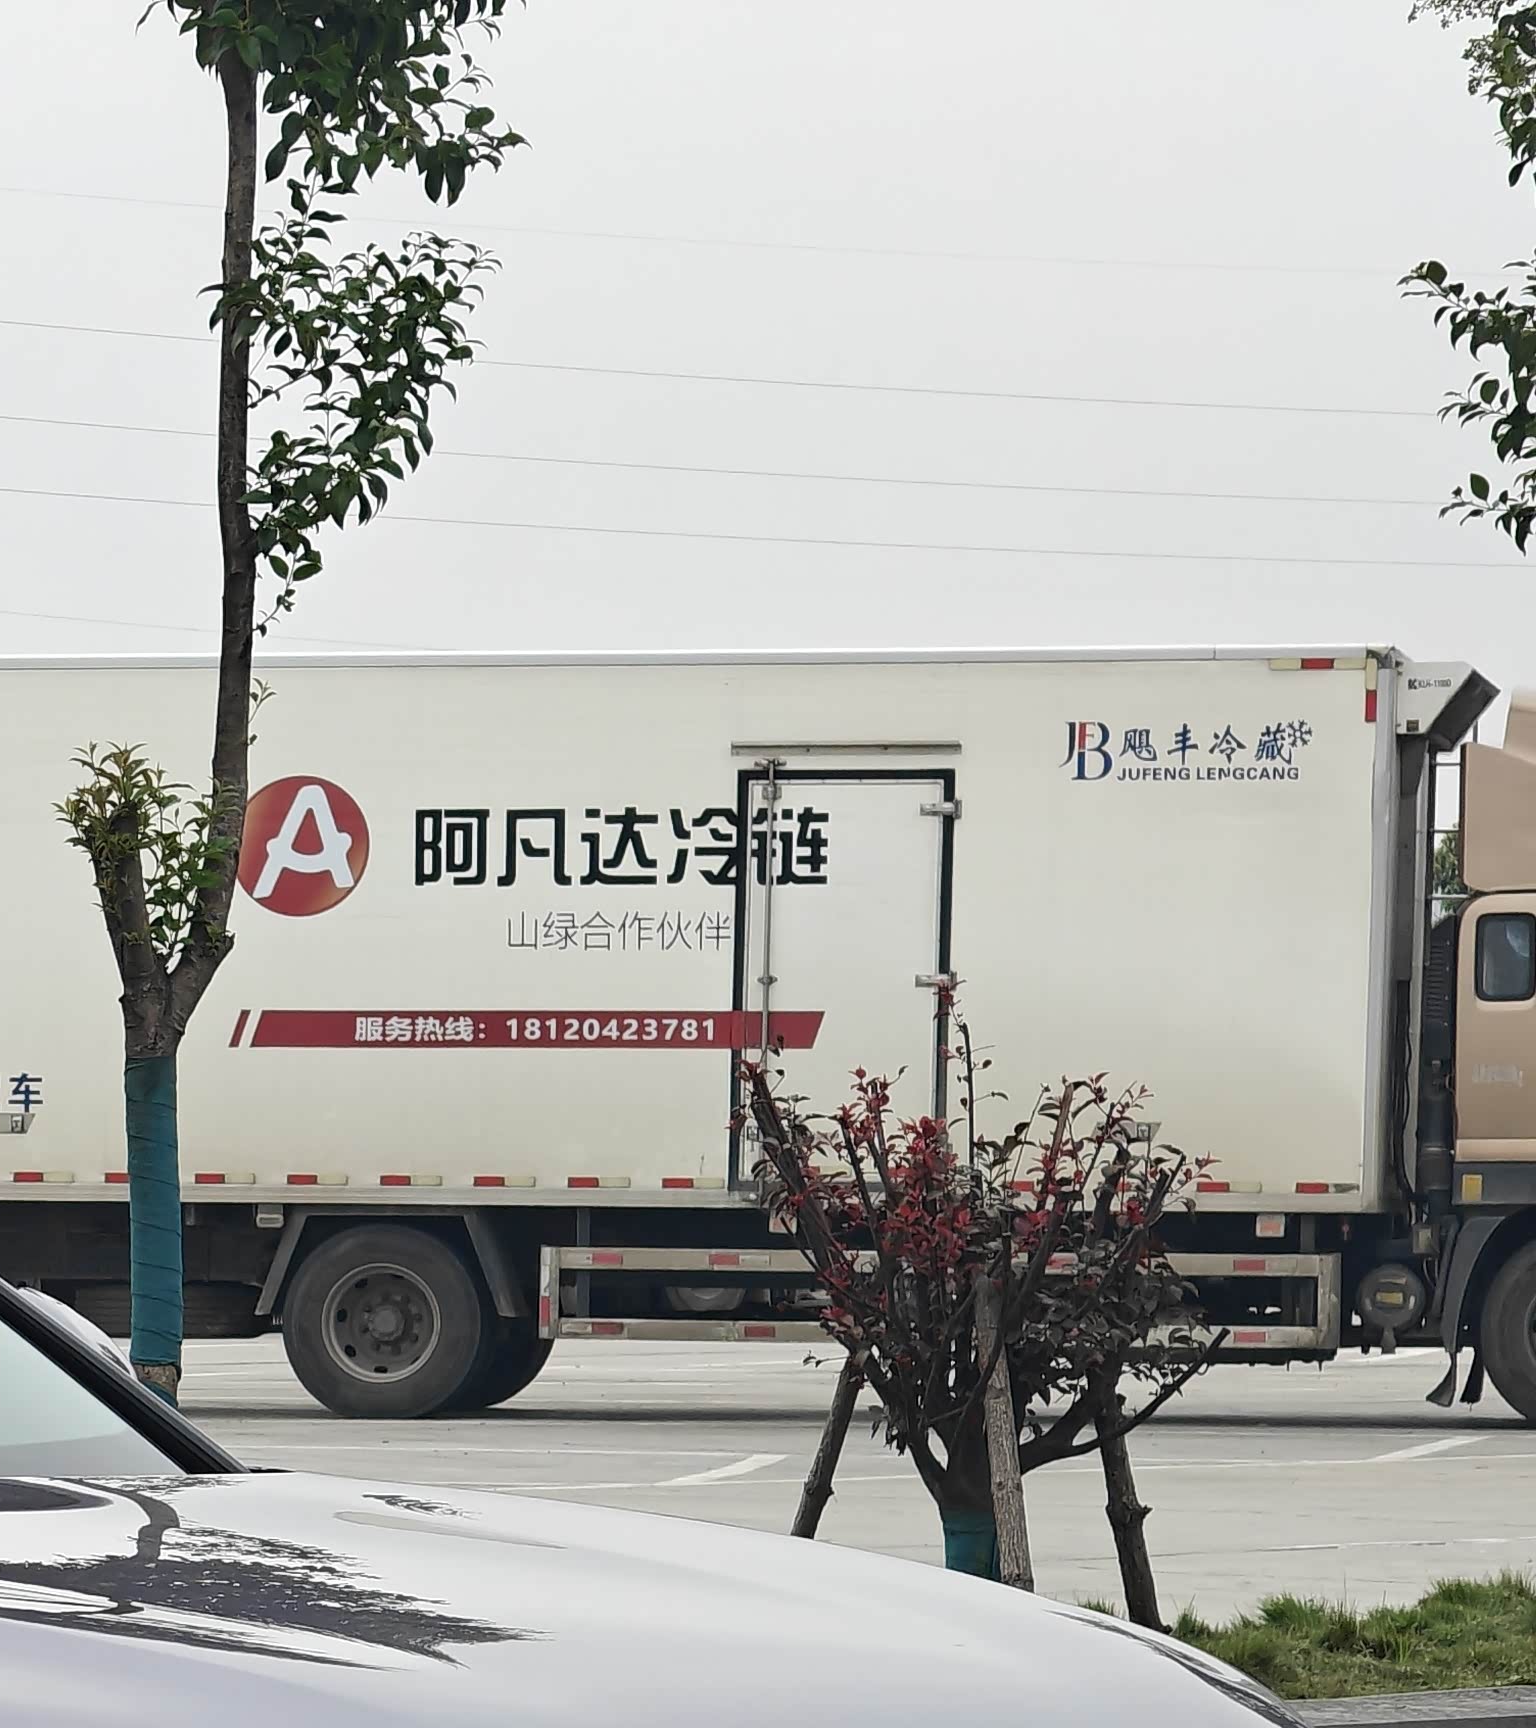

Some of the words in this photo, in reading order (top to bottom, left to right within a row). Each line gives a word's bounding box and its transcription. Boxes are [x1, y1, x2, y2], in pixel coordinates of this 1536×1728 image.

[1119, 723, 1293, 766] 飓丰冷藏
[1116, 766, 1191, 781] JUFENG
[1196, 766, 1299, 781] LENGCANG
[414, 806, 830, 887] 阿凡达冷链
[506, 911, 732, 951] 山绿合作伙伴
